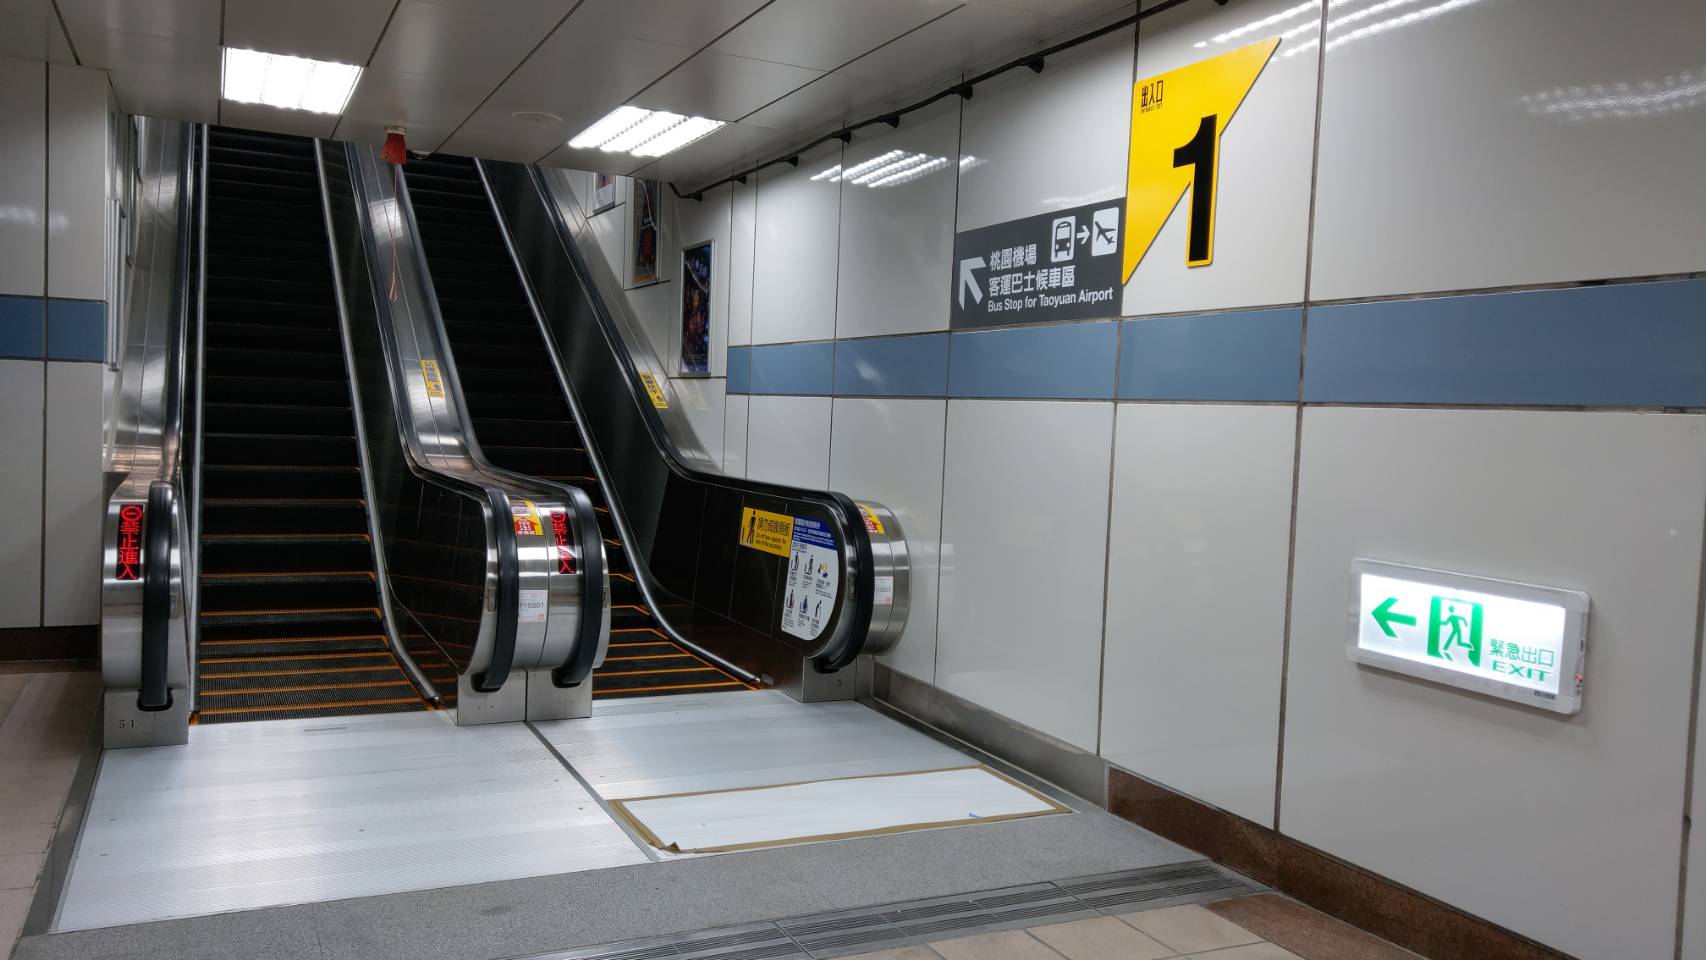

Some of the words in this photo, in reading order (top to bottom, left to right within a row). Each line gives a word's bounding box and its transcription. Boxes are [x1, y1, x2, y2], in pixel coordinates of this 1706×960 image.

[1141, 80, 1164, 107] 出入口
[1173, 114, 1217, 262] 1
[989, 244, 1037, 271] 桃園機場
[988, 265, 1076, 297] 客運巴士候車區
[988, 300, 1003, 312] Bus
[1004, 299, 1023, 312] Stop
[1025, 297, 1036, 308] for
[1039, 293, 1076, 308] Taoyuan
[1078, 287, 1114, 305] Airport
[118, 520, 141, 579] 禁止進入
[1489, 639, 1554, 667] 緊急出口
[1492, 661, 1551, 681] EXIT
